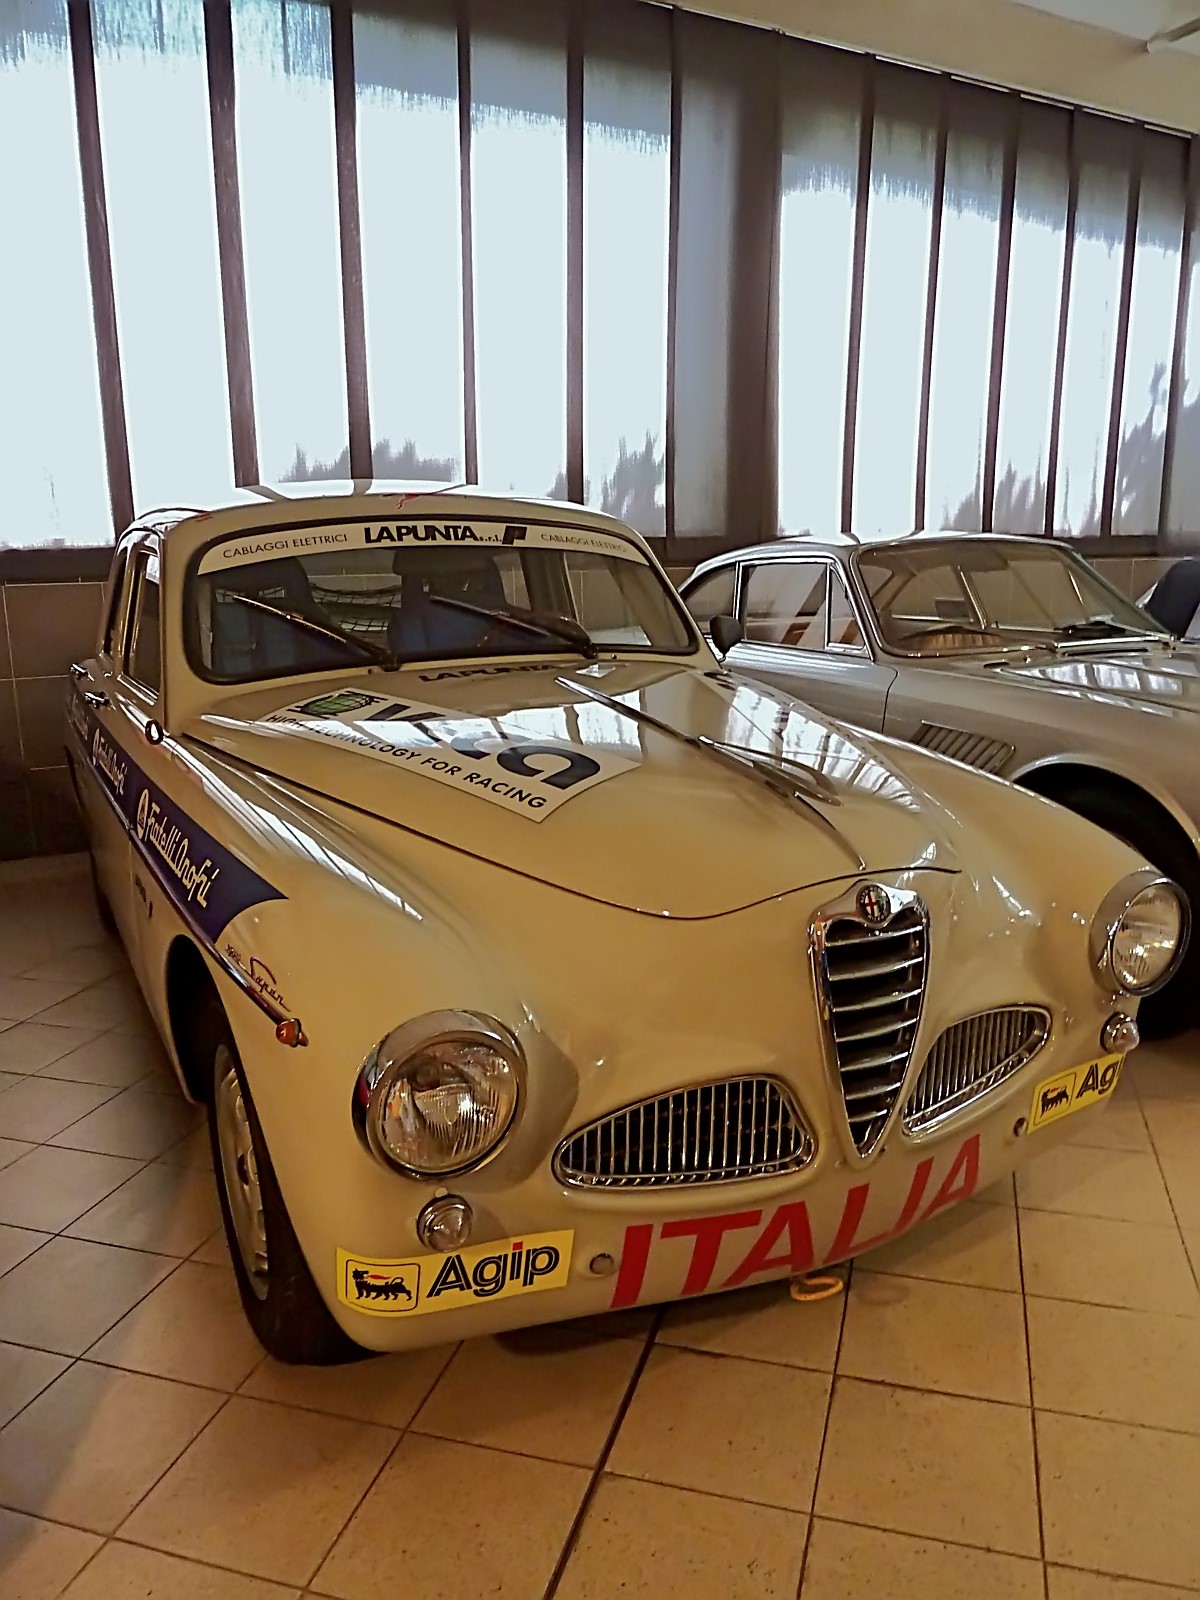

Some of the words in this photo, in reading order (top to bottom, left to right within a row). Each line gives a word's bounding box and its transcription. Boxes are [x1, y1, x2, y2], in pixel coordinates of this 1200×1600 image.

[223, 540, 289, 559] CABLAGGI
[293, 534, 348, 548] ELETTRICI
[364, 524, 480, 544] LAPUNTA
[540, 533, 588, 546] CABLAGGI
[420, 759, 463, 777] FOR
[463, 771, 547, 809] RACING
[610, 1133, 981, 1309] ITALIA
[426, 1241, 560, 1298] Agip
